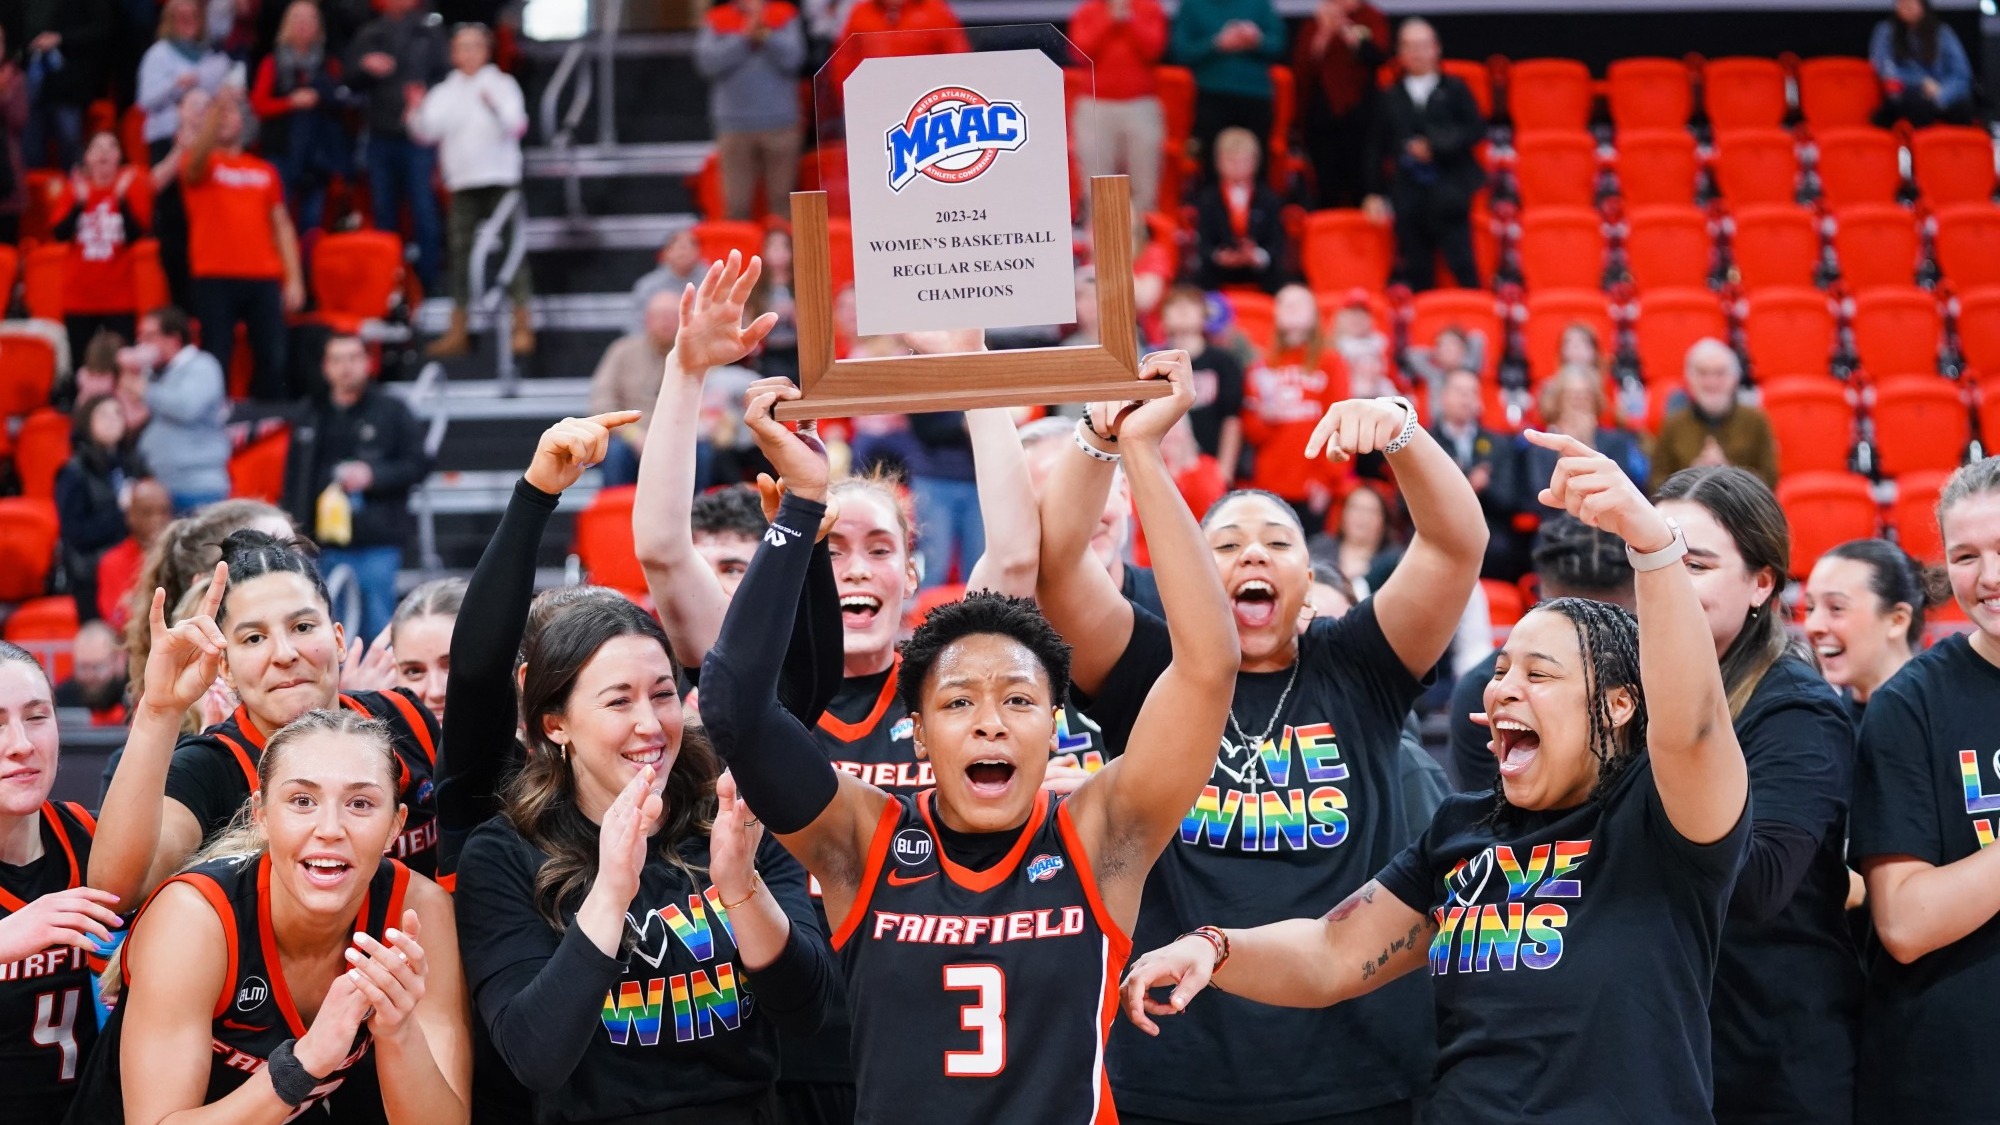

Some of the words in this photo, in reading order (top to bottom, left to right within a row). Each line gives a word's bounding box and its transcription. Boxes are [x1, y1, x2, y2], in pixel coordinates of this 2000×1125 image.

[915, 94, 939, 114] METRO
[941, 91, 978, 104] ATLANTIC
[888, 103, 1024, 190] MAAC
[925, 166, 957, 180] ATHLETIC
[958, 149, 994, 179] CONFERENCE
[935, 209, 988, 223] 2023-24
[869, 237, 947, 253] WOMEN'S
[951, 231, 1056, 248] BASKETBALL
[892, 261, 970, 277] REGULAR
[974, 258, 1035, 272] SEASON
[917, 285, 1014, 301] CHAMPIONS
[830, 760, 937, 787] FIELD
[1179, 785, 1350, 852] WINS
[897, 837, 930, 855] BLM
[1028, 856, 1063, 883] MAAC
[873, 905, 1085, 945] FAIRFIELD
[238, 986, 265, 1003] BLM
[943, 964, 1006, 1077] 3
[31, 987, 81, 1083] 4
